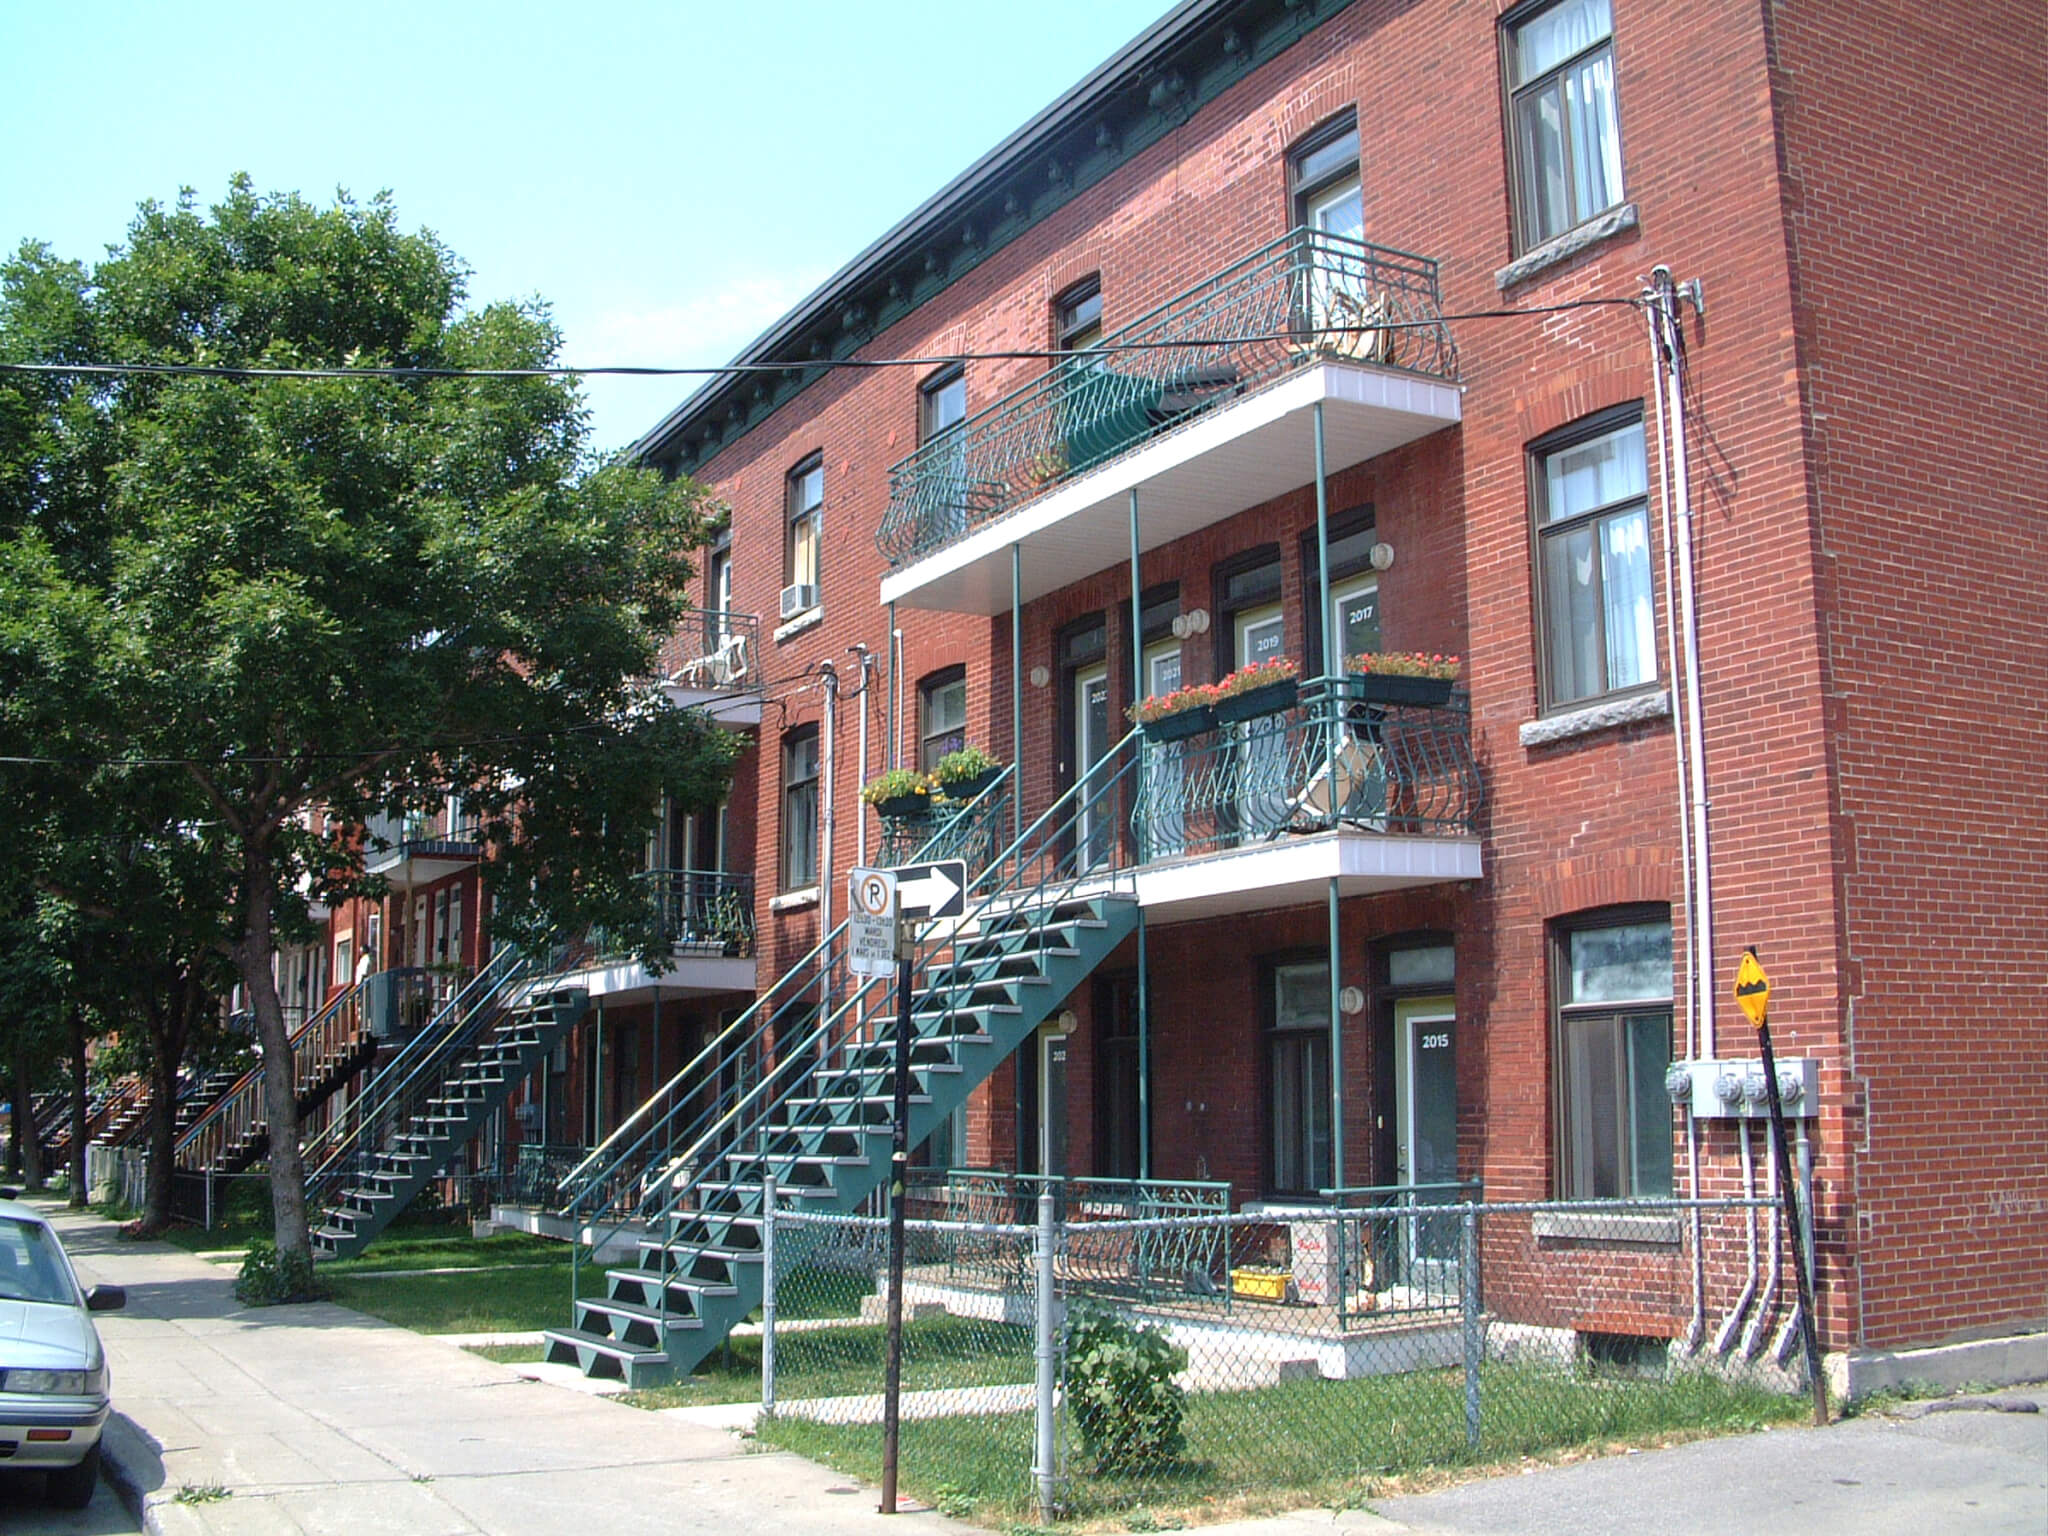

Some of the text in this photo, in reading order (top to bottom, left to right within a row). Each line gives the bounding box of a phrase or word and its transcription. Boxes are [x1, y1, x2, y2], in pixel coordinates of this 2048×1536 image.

[1349, 605, 1374, 625] 2017
[1256, 635, 1280, 652] 2019
[870, 883, 881, 905] P
[1422, 1033, 1449, 1049] 2015
